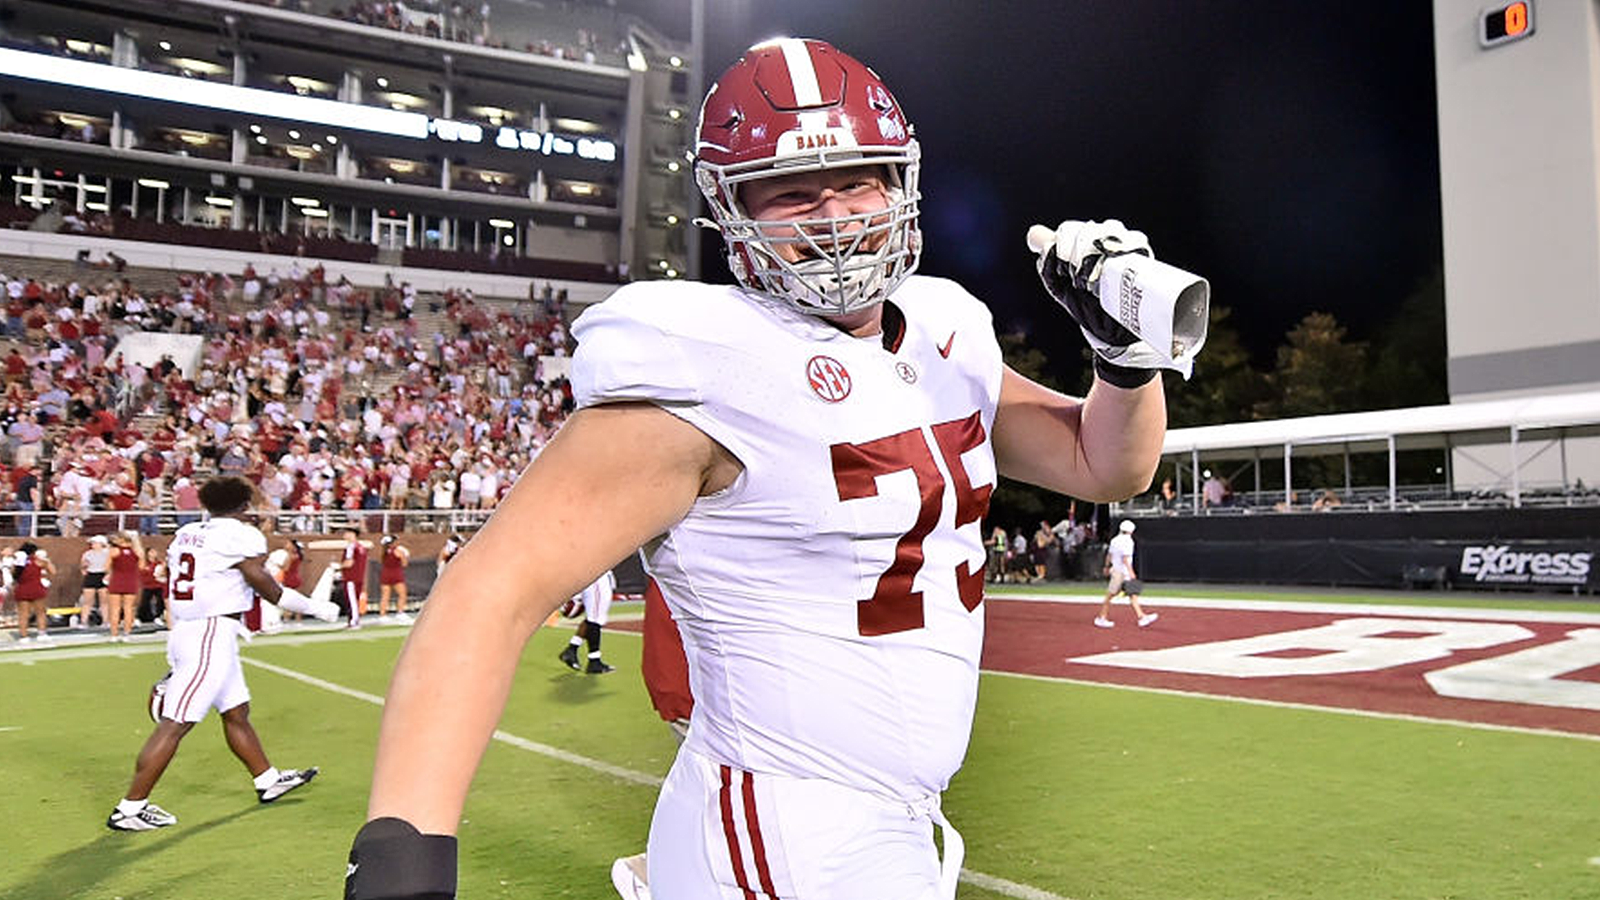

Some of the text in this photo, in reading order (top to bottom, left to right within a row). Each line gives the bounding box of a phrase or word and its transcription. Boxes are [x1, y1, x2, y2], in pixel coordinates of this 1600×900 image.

[1505, 2, 1527, 36] 0
[796, 133, 838, 150] BAMA
[807, 355, 852, 402] SEC
[830, 410, 993, 637] 75
[172, 552, 195, 601] 2
